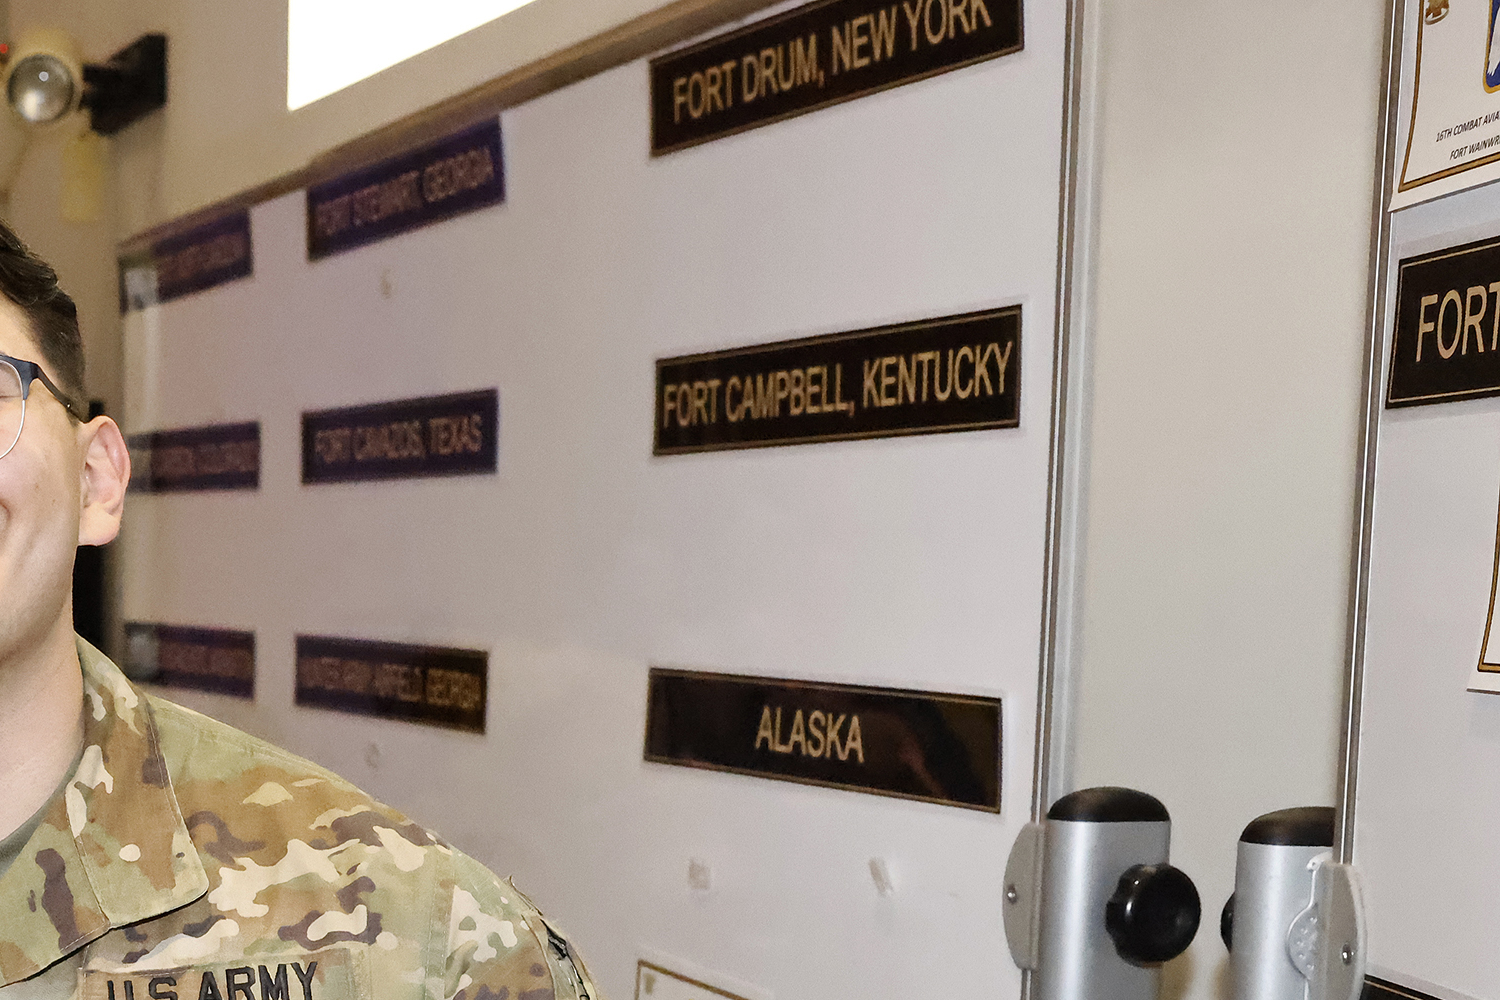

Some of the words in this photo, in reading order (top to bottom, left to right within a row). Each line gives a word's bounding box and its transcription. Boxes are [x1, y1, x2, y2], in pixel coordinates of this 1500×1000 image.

[673, 60, 738, 125] FORT
[742, 33, 825, 103] DRUM,
[831, 5, 898, 76] NEW
[903, 0, 992, 51] YORK
[1436, 128, 1453, 143] 16TH
[1453, 117, 1483, 136] COMBAT
[1450, 146, 1468, 160] FORT
[662, 379, 722, 429] FORT
[725, 362, 856, 424] CAMPBELL,
[862, 340, 1014, 409] KENTUCKY
[315, 427, 351, 464] FORT
[429, 413, 483, 455] TEXAS
[754, 705, 865, 763] ALASKA
